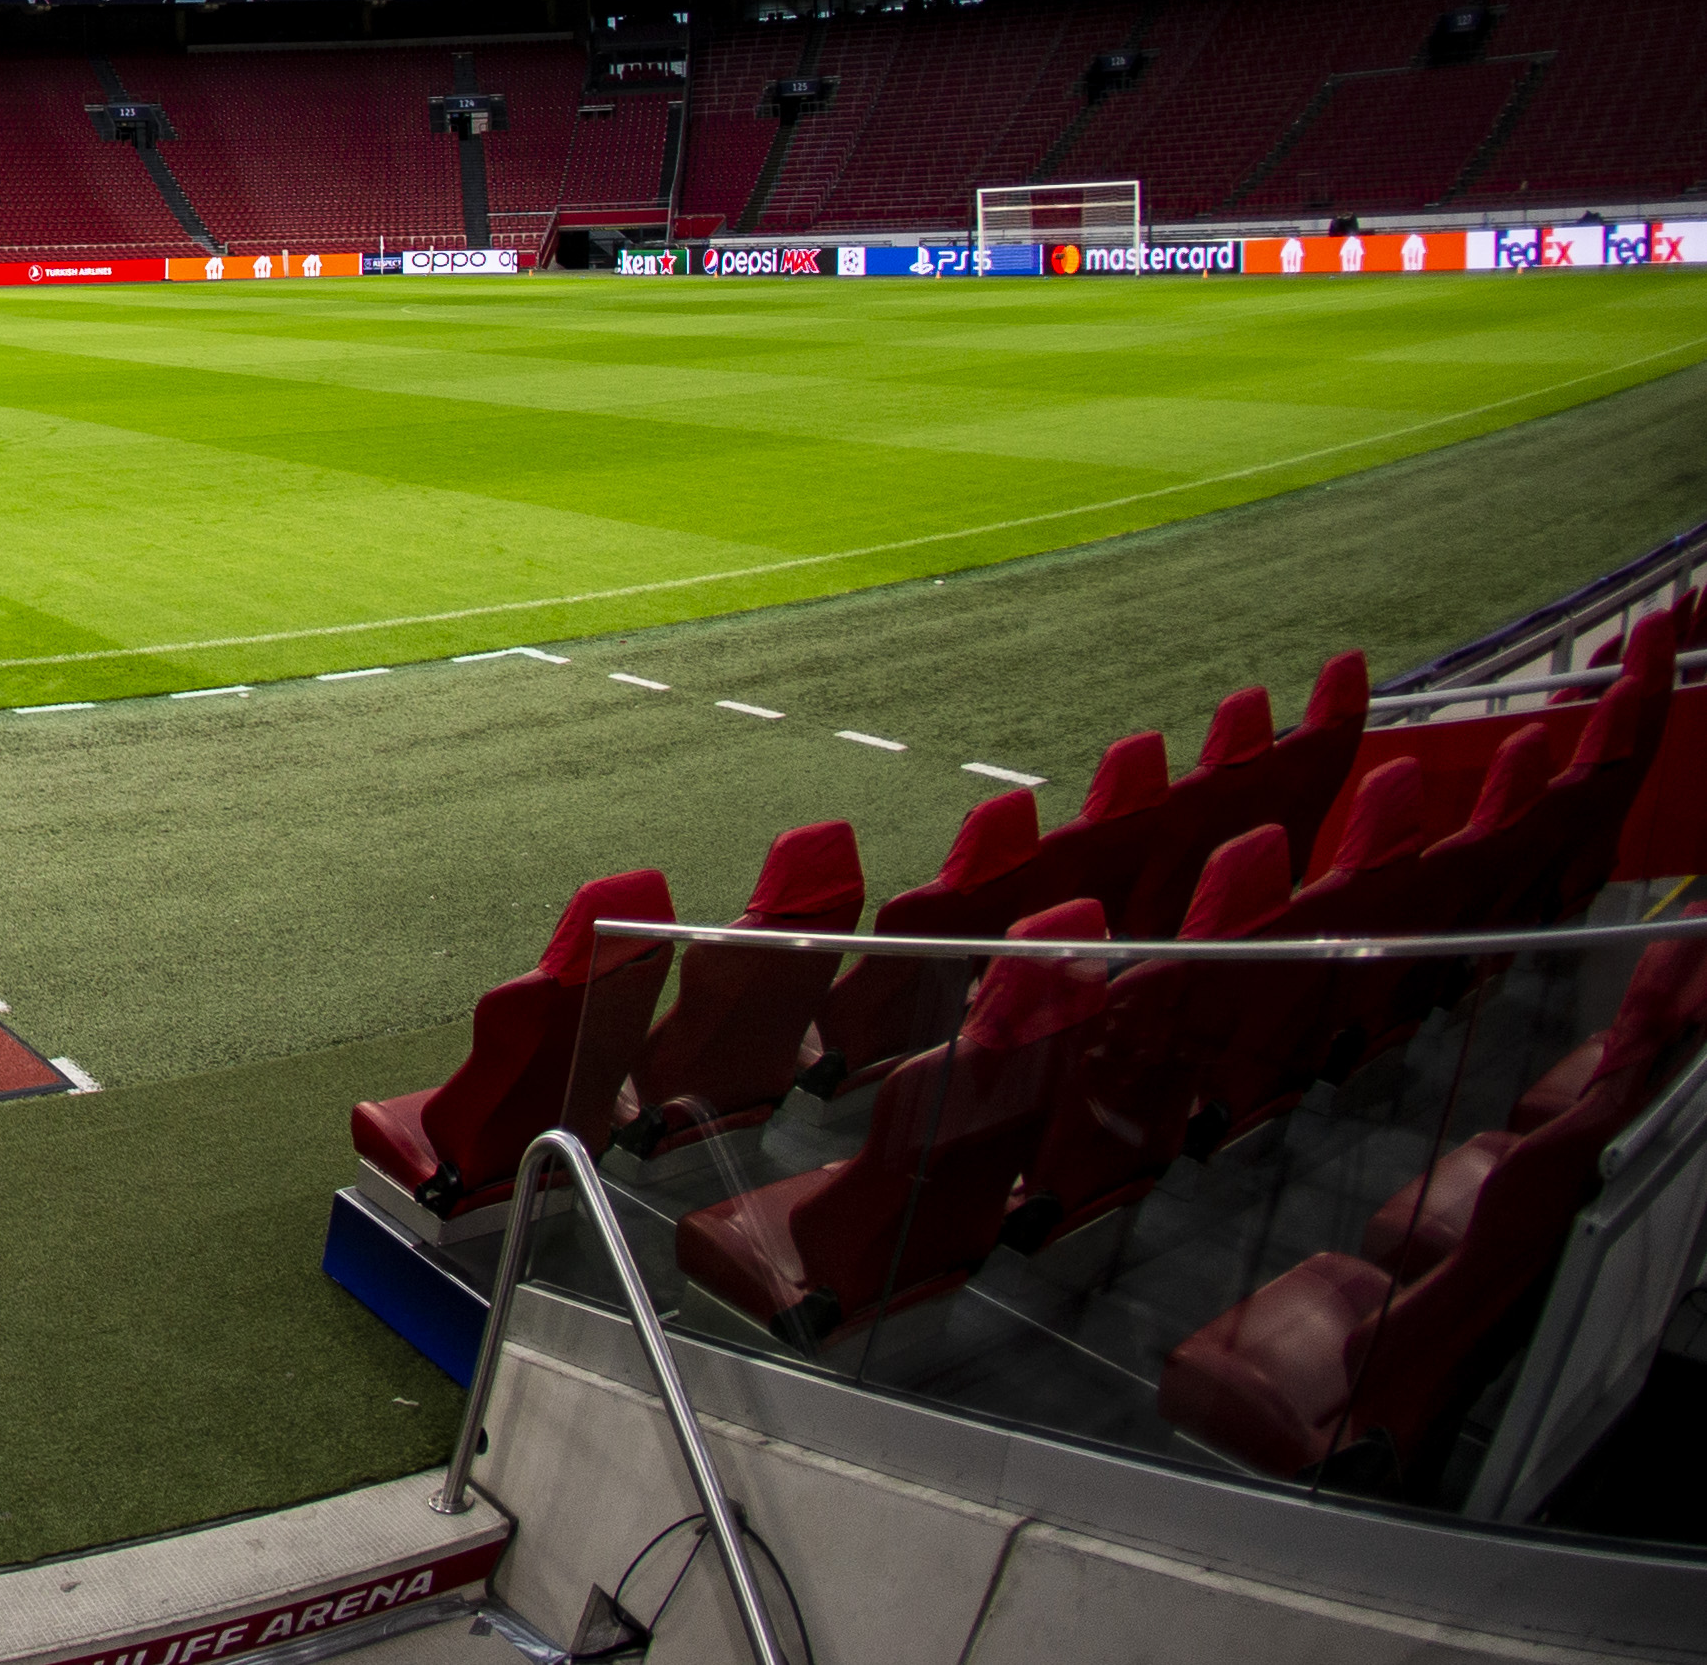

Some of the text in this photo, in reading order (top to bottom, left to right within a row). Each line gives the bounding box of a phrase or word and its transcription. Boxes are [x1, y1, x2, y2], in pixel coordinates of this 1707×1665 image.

[792, 82, 808, 92] 125
[119, 108, 137, 117] 123
[459, 99, 475, 108] 124
[1496, 227, 1575, 268] FedEx
[1603, 222, 1685, 265] FedEx
[412, 252, 487, 272] oppo
[721, 248, 822, 275] pepsi MAX
[938, 250, 992, 271] PS5
[1085, 240, 1235, 271] mastercard
[45, 268, 78, 277] TURKISH
[256, 1569, 434, 1644] ARENA
